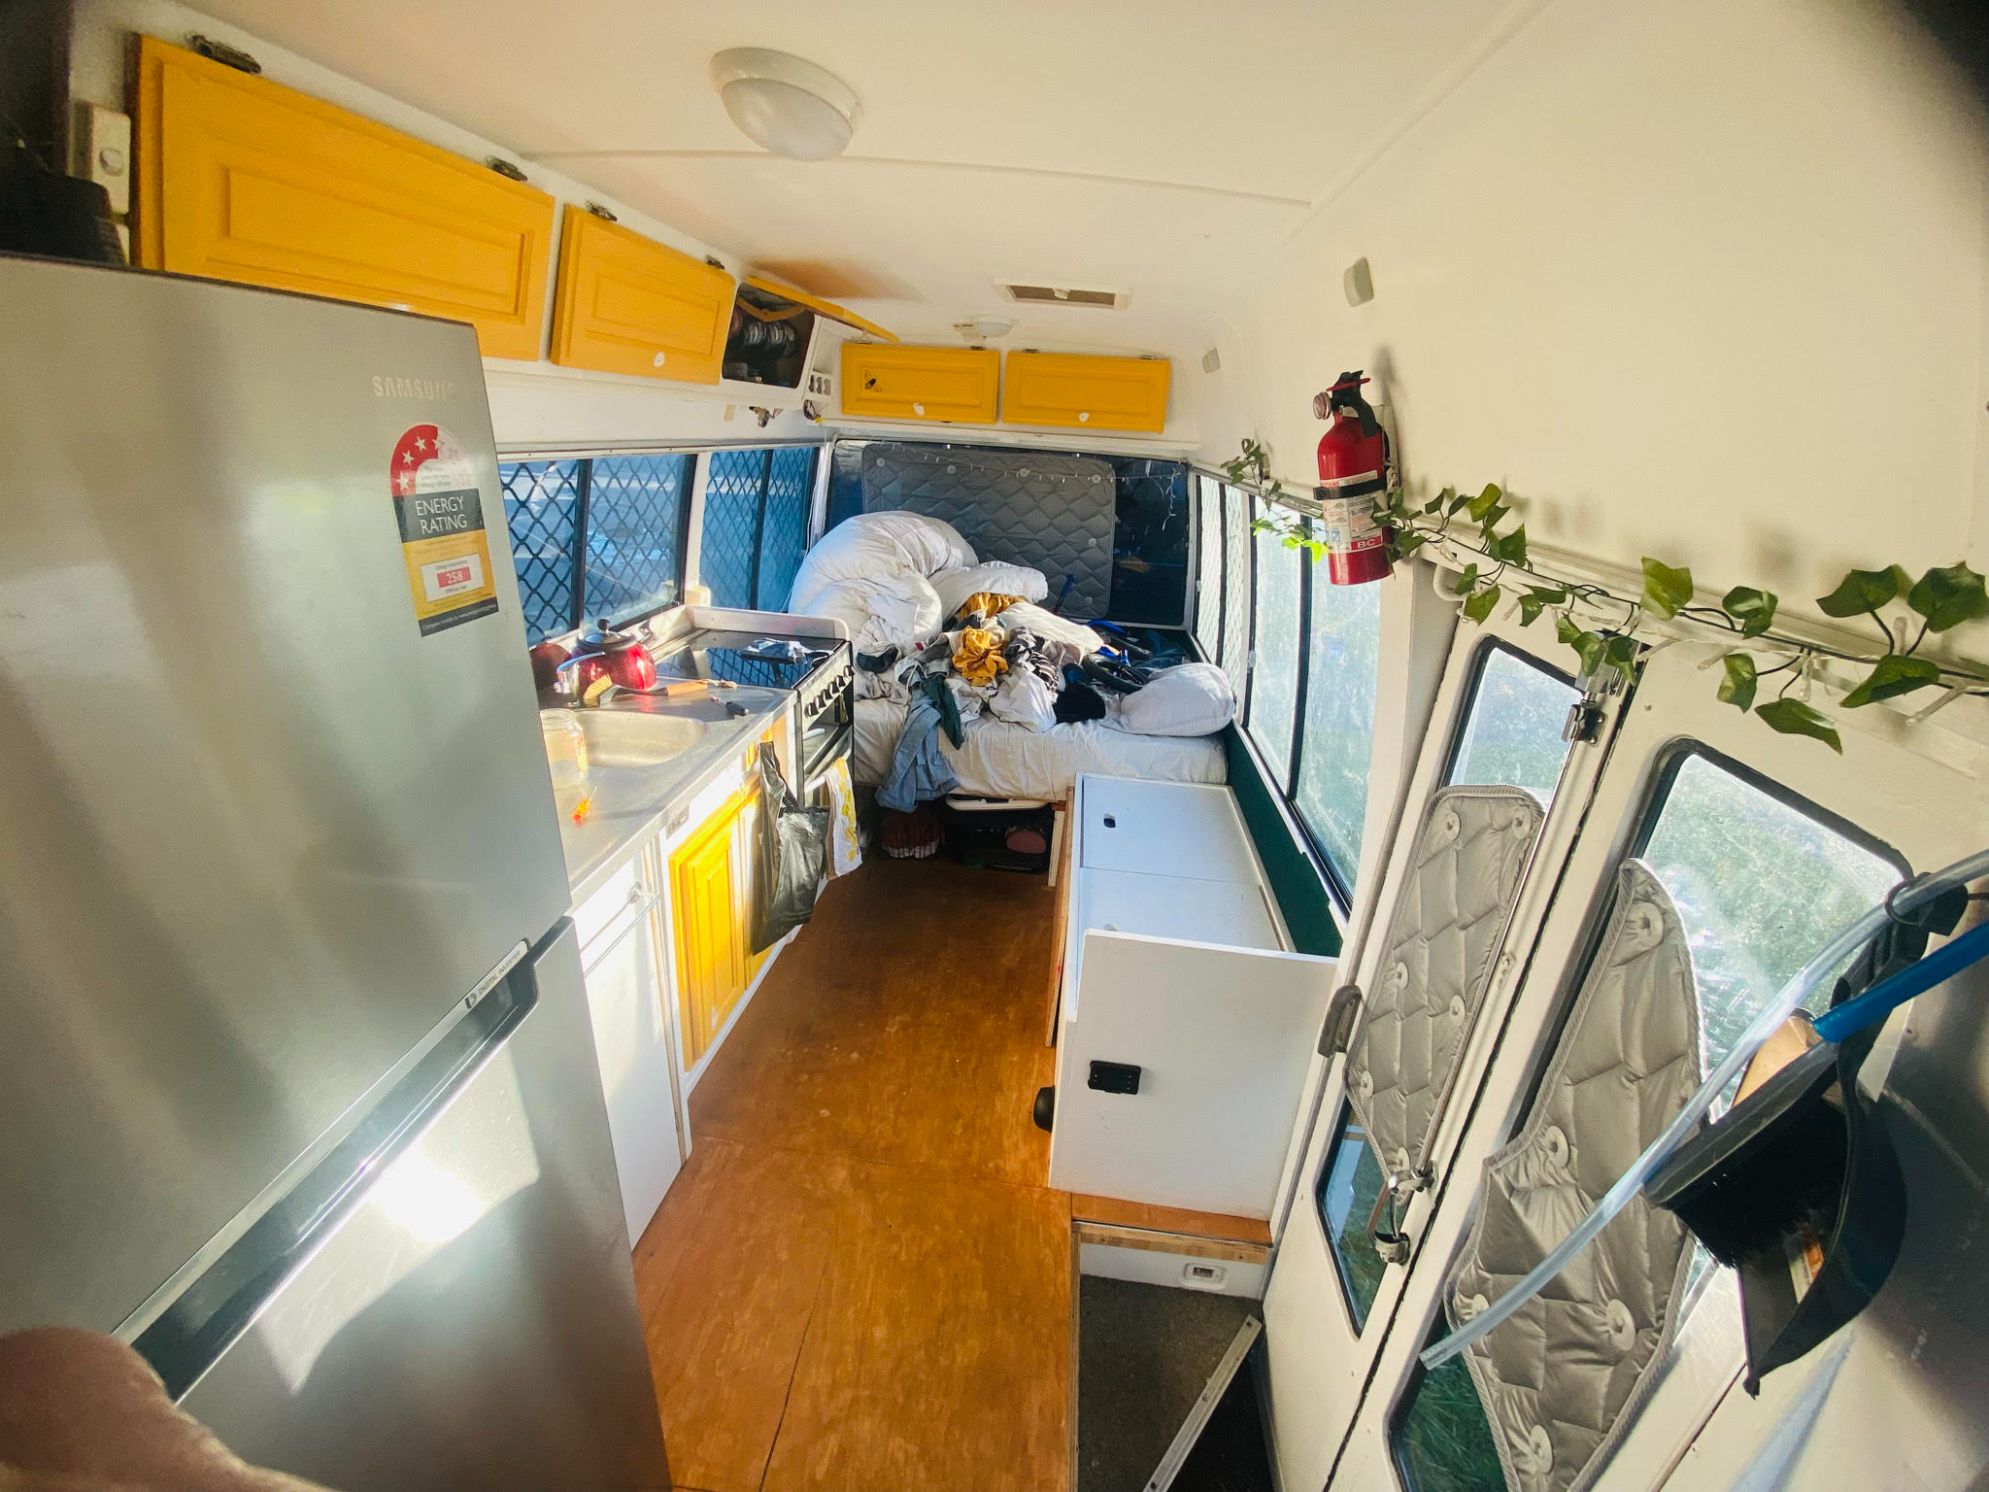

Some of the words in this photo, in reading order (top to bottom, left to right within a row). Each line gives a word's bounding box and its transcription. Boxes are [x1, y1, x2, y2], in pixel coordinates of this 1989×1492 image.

[415, 495, 464, 516] ENERGY
[420, 513, 467, 535] RATING
[1357, 539, 1376, 549] BC
